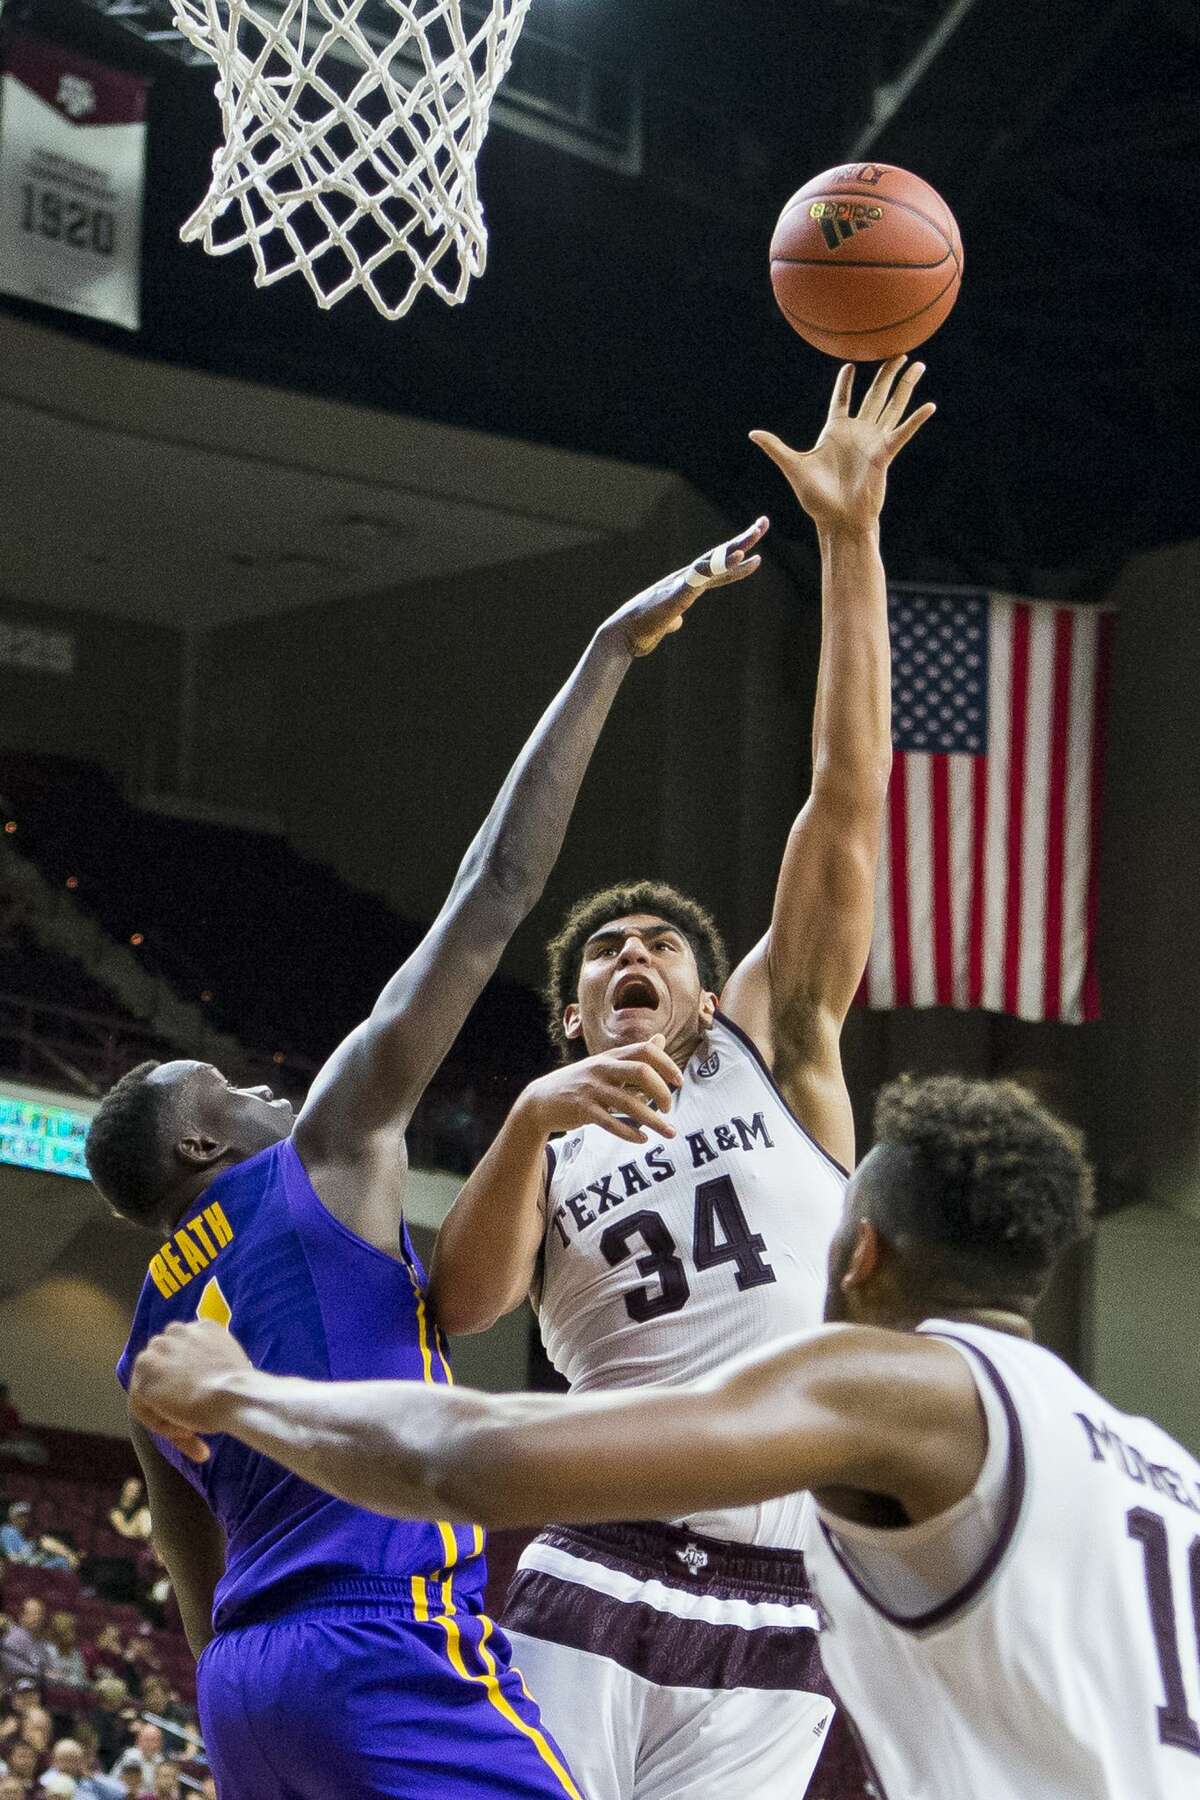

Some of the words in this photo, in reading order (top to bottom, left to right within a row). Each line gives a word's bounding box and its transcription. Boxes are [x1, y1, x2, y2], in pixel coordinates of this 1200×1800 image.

[20, 182, 115, 257] 1920
[553, 1144, 676, 1249] TEXAS
[685, 1111, 775, 1168] A&M
[149, 1201, 234, 1299] REATH
[600, 1174, 777, 1324] 34
[1072, 1412, 1200, 1515] MORE
